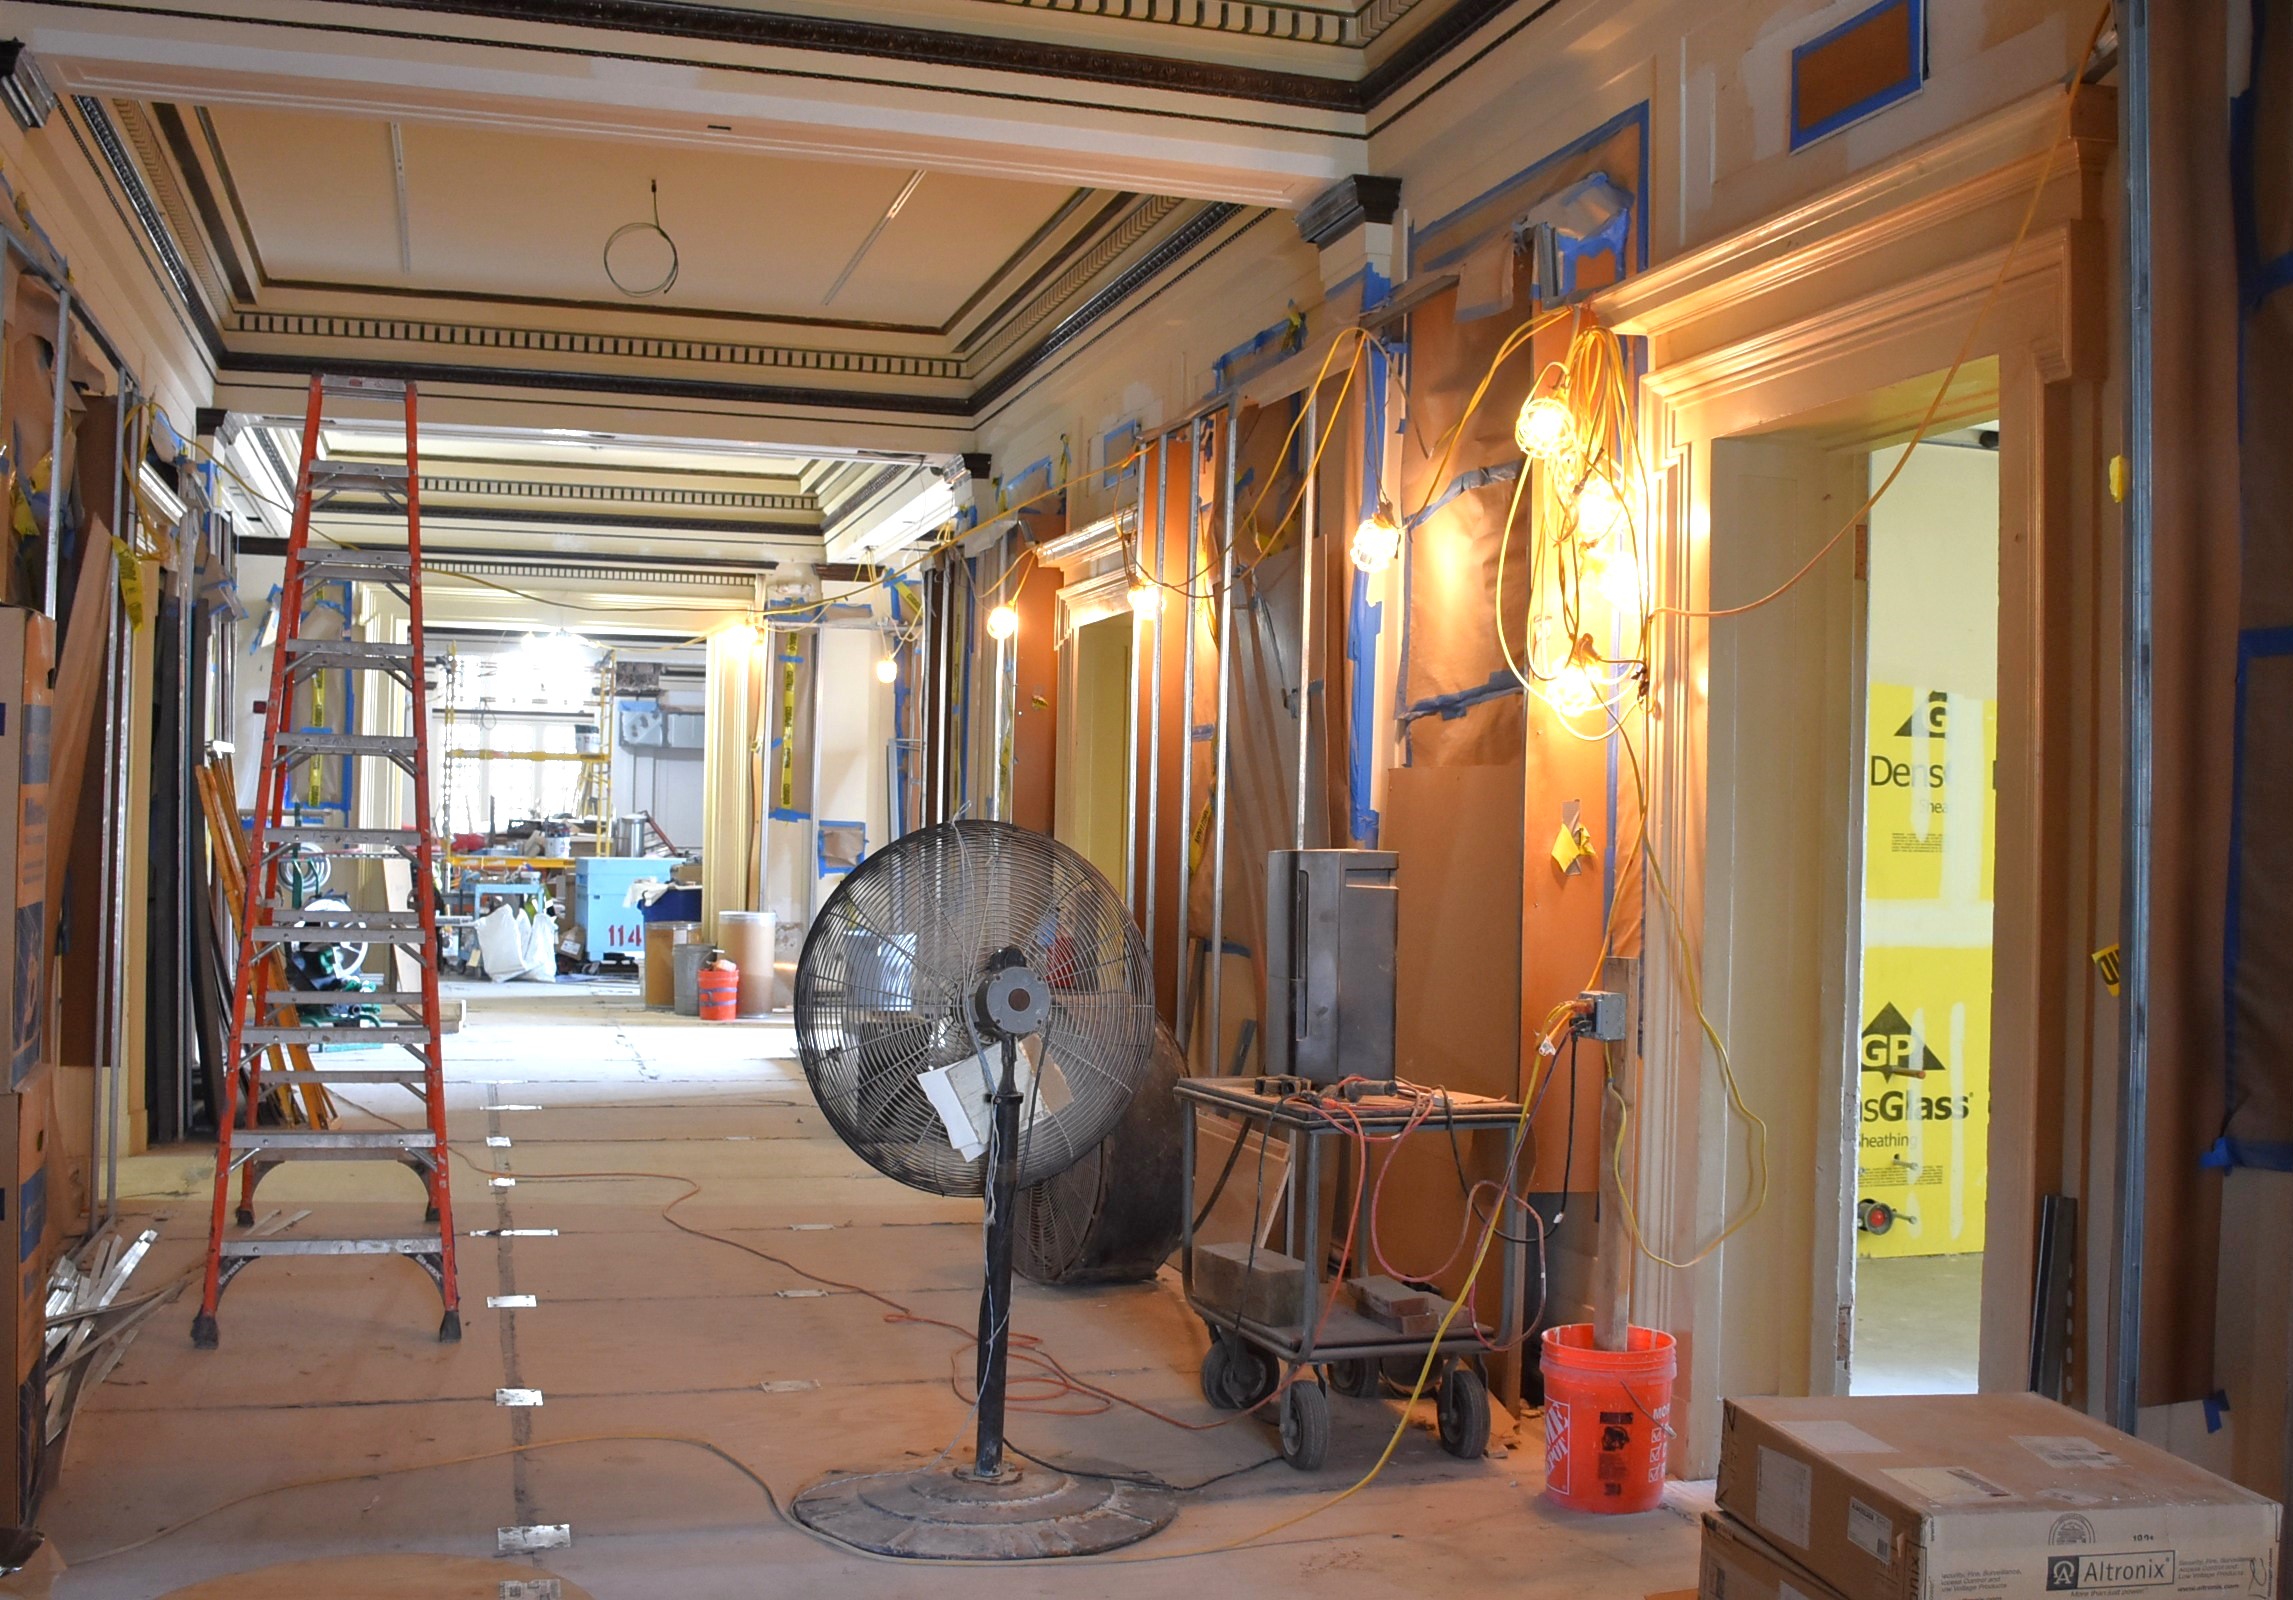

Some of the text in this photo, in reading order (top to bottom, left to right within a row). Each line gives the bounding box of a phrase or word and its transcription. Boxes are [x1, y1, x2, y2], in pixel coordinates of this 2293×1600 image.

[608, 924, 642, 947] 114
[1860, 1090, 1969, 1122] sGlass
[2084, 1558, 2165, 1582] Altronix
